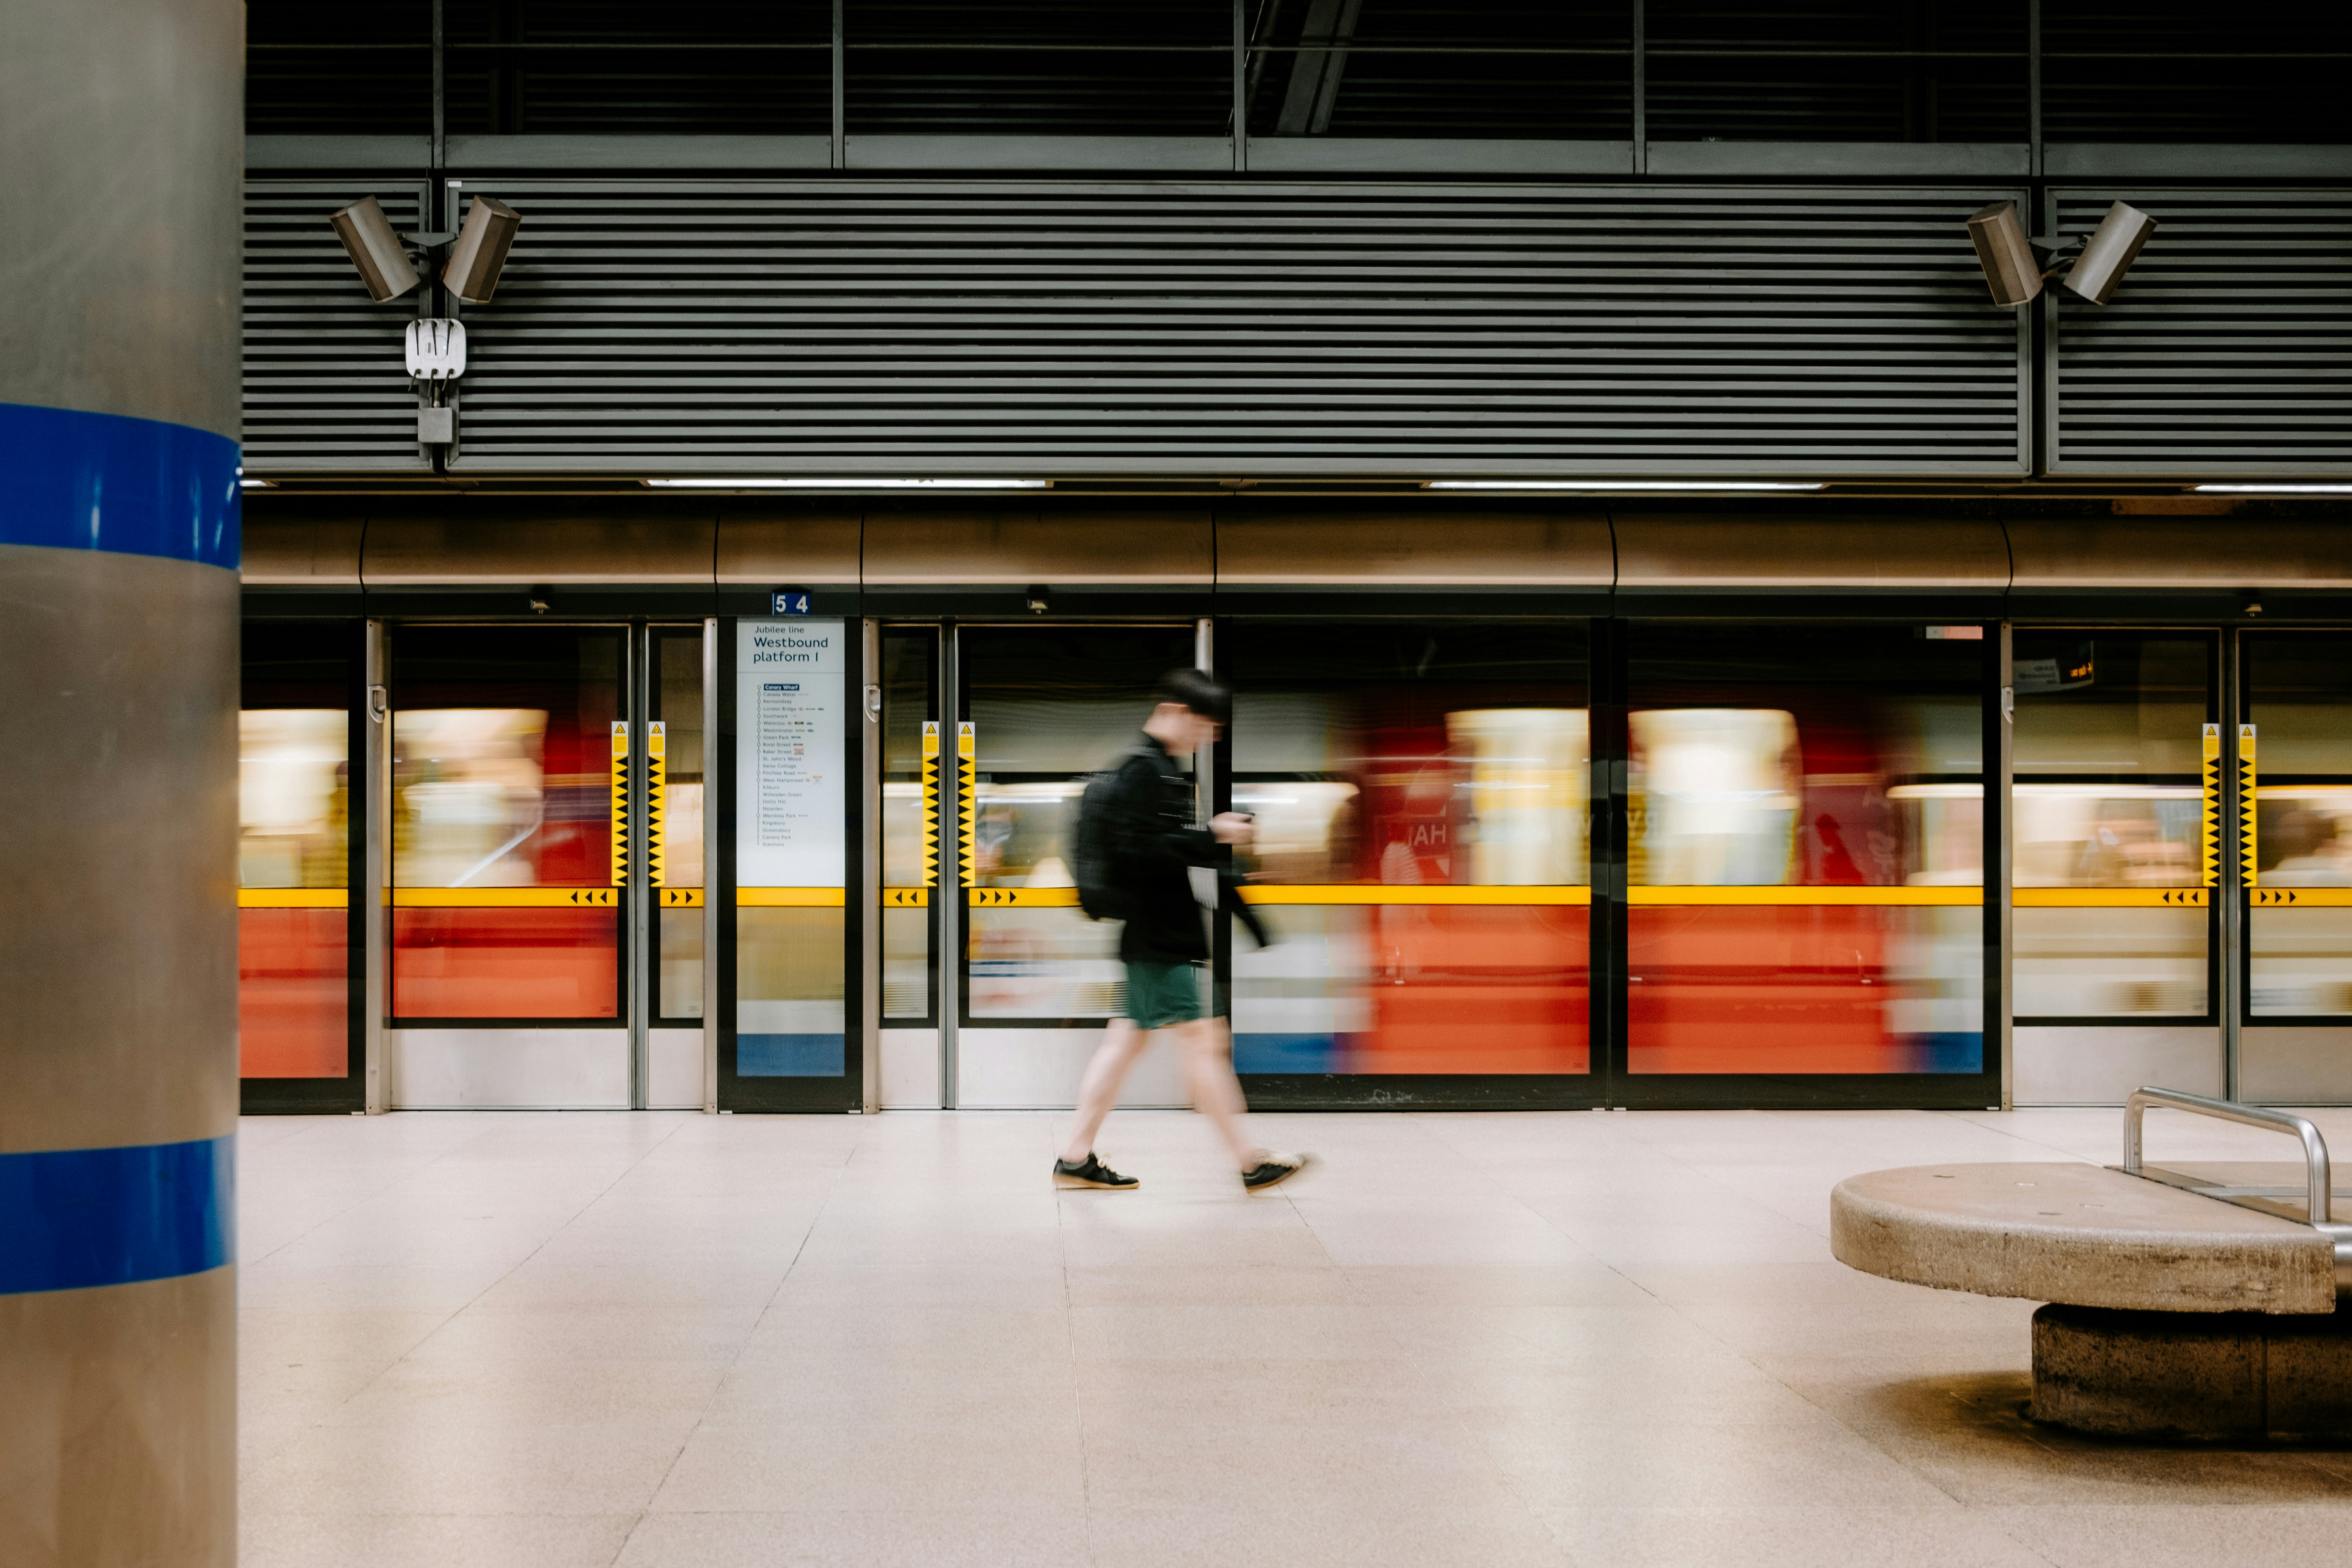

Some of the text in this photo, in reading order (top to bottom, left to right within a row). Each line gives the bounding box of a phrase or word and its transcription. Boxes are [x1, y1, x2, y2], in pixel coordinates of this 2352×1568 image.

[776, 595, 807, 613] 5 4
[754, 637, 828, 647] Westbound
[754, 651, 809, 664] platform
